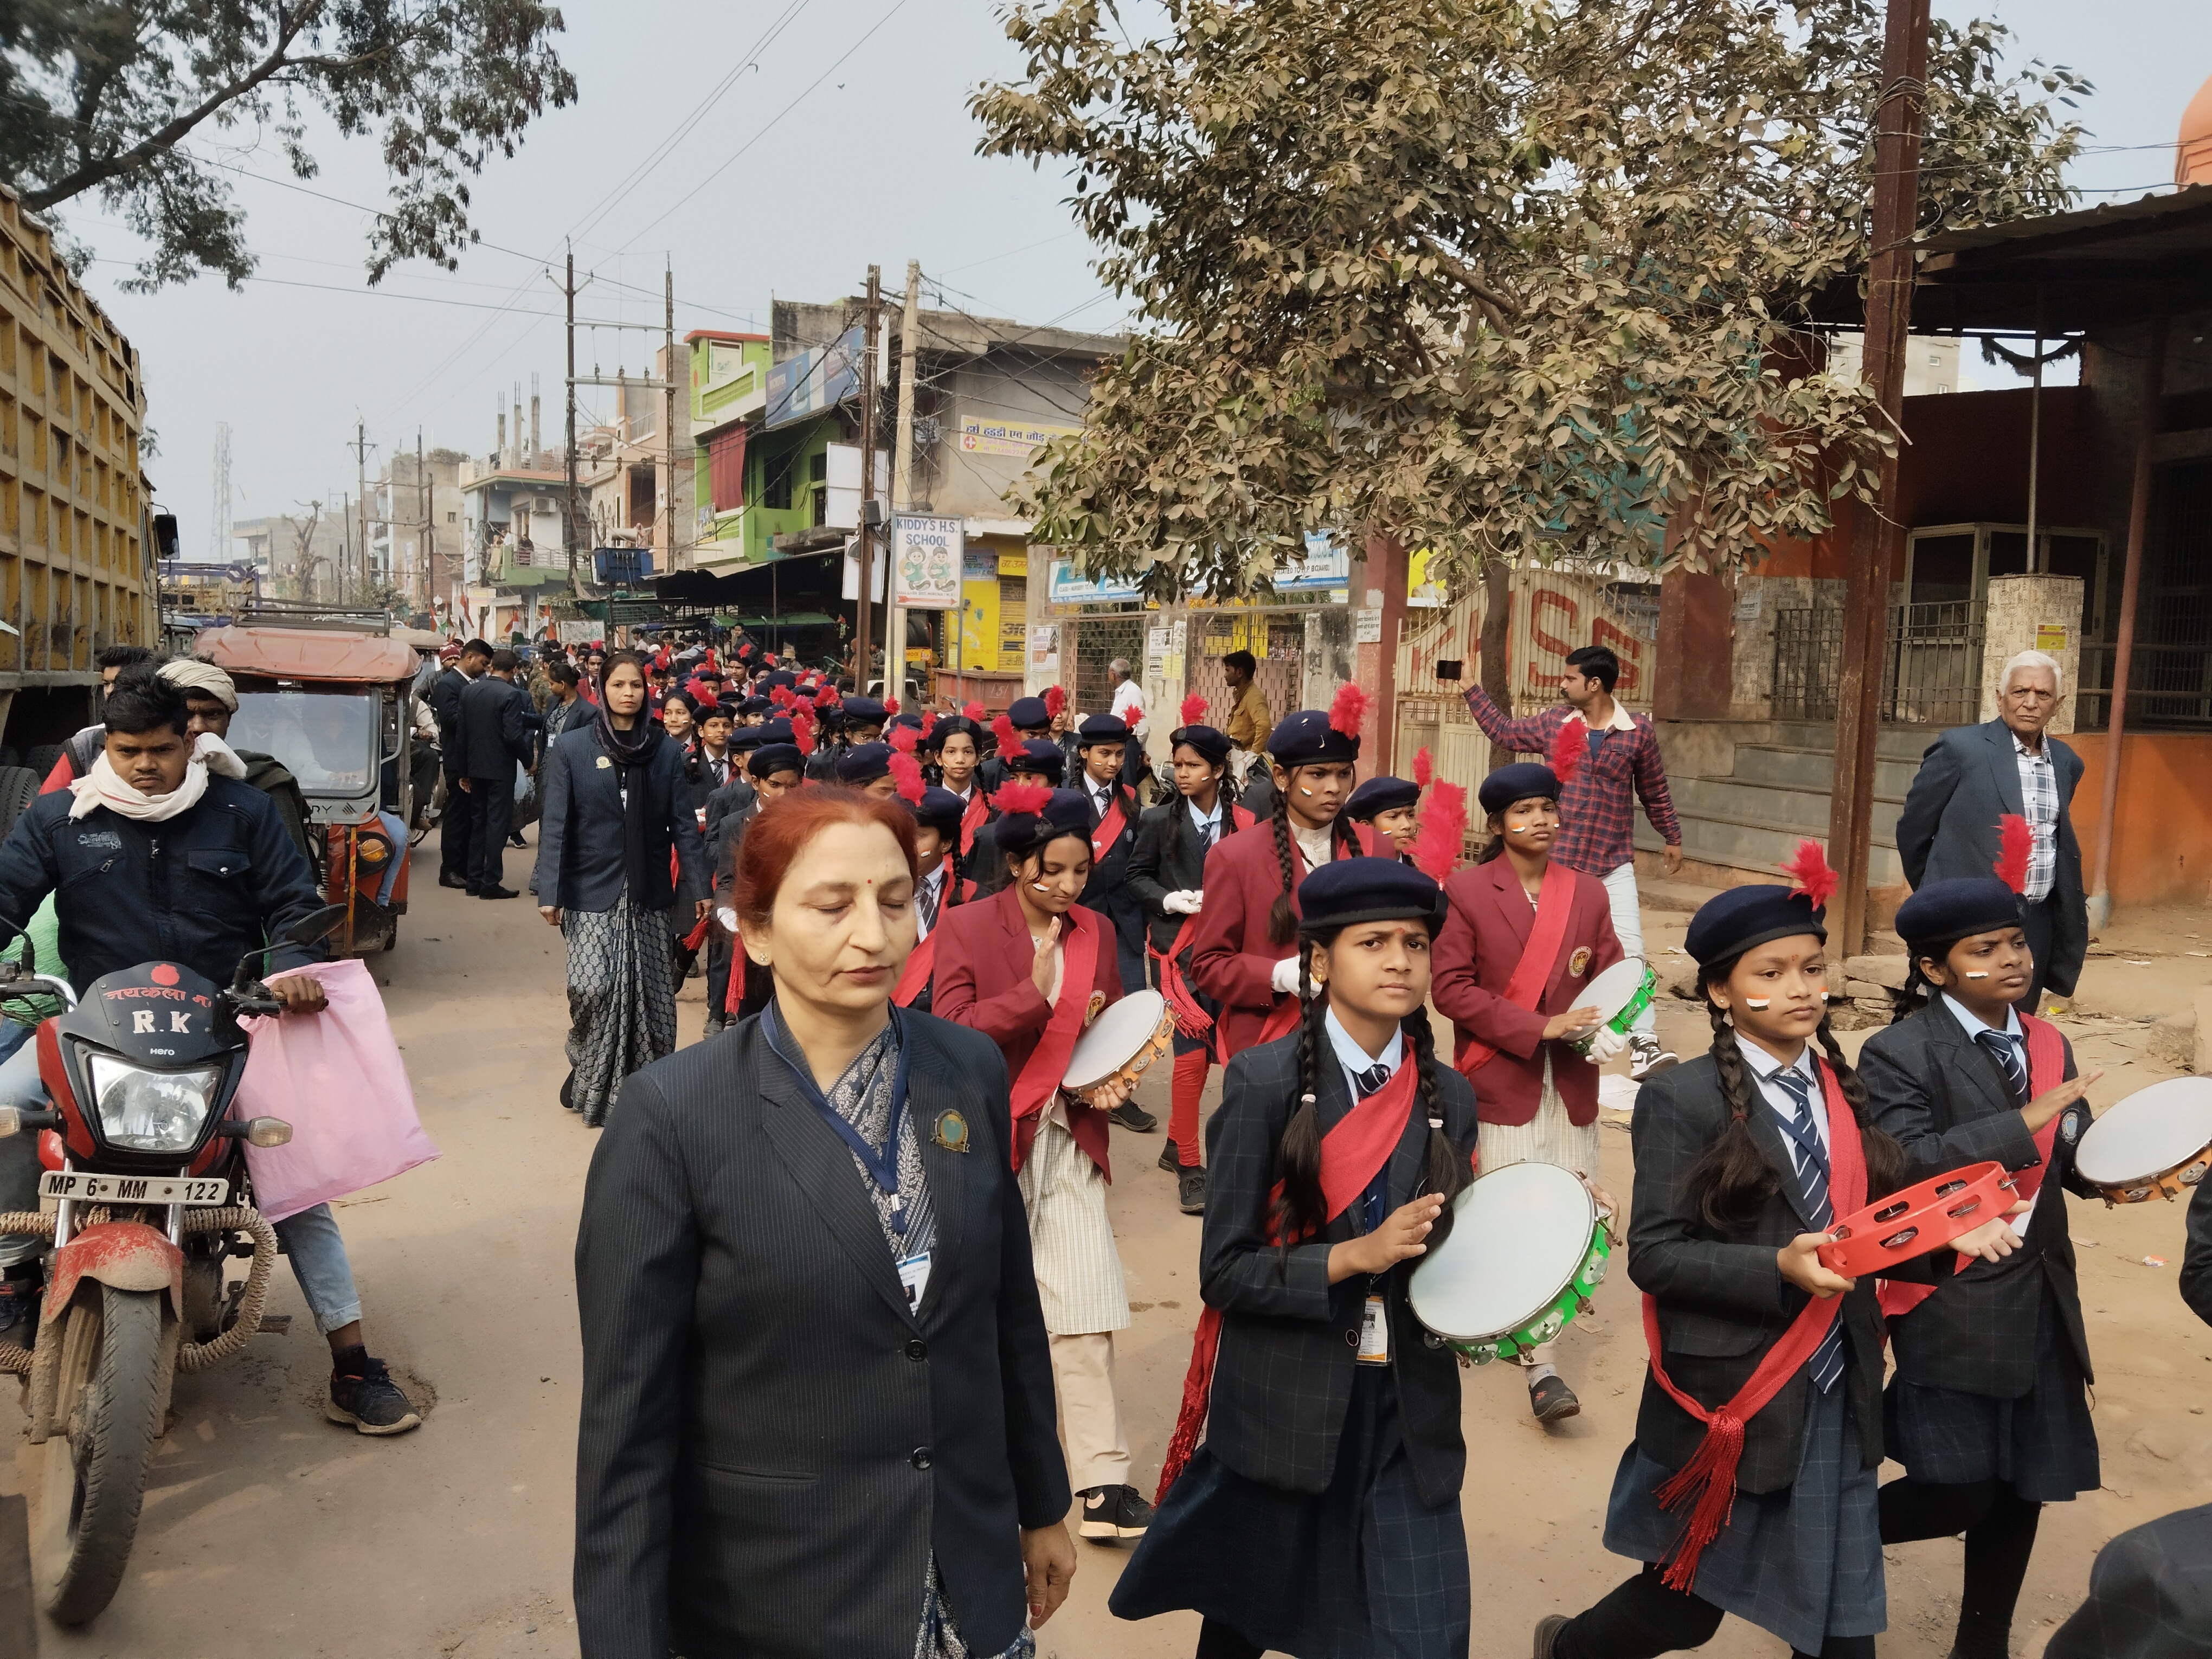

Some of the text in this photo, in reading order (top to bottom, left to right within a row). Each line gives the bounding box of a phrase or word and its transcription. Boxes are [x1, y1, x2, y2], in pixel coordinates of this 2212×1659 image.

[906, 533, 950, 548] SCHOOL
[150, 1047, 175, 1056] Hero
[48, 1175, 220, 1201] MP 6 MM 122
